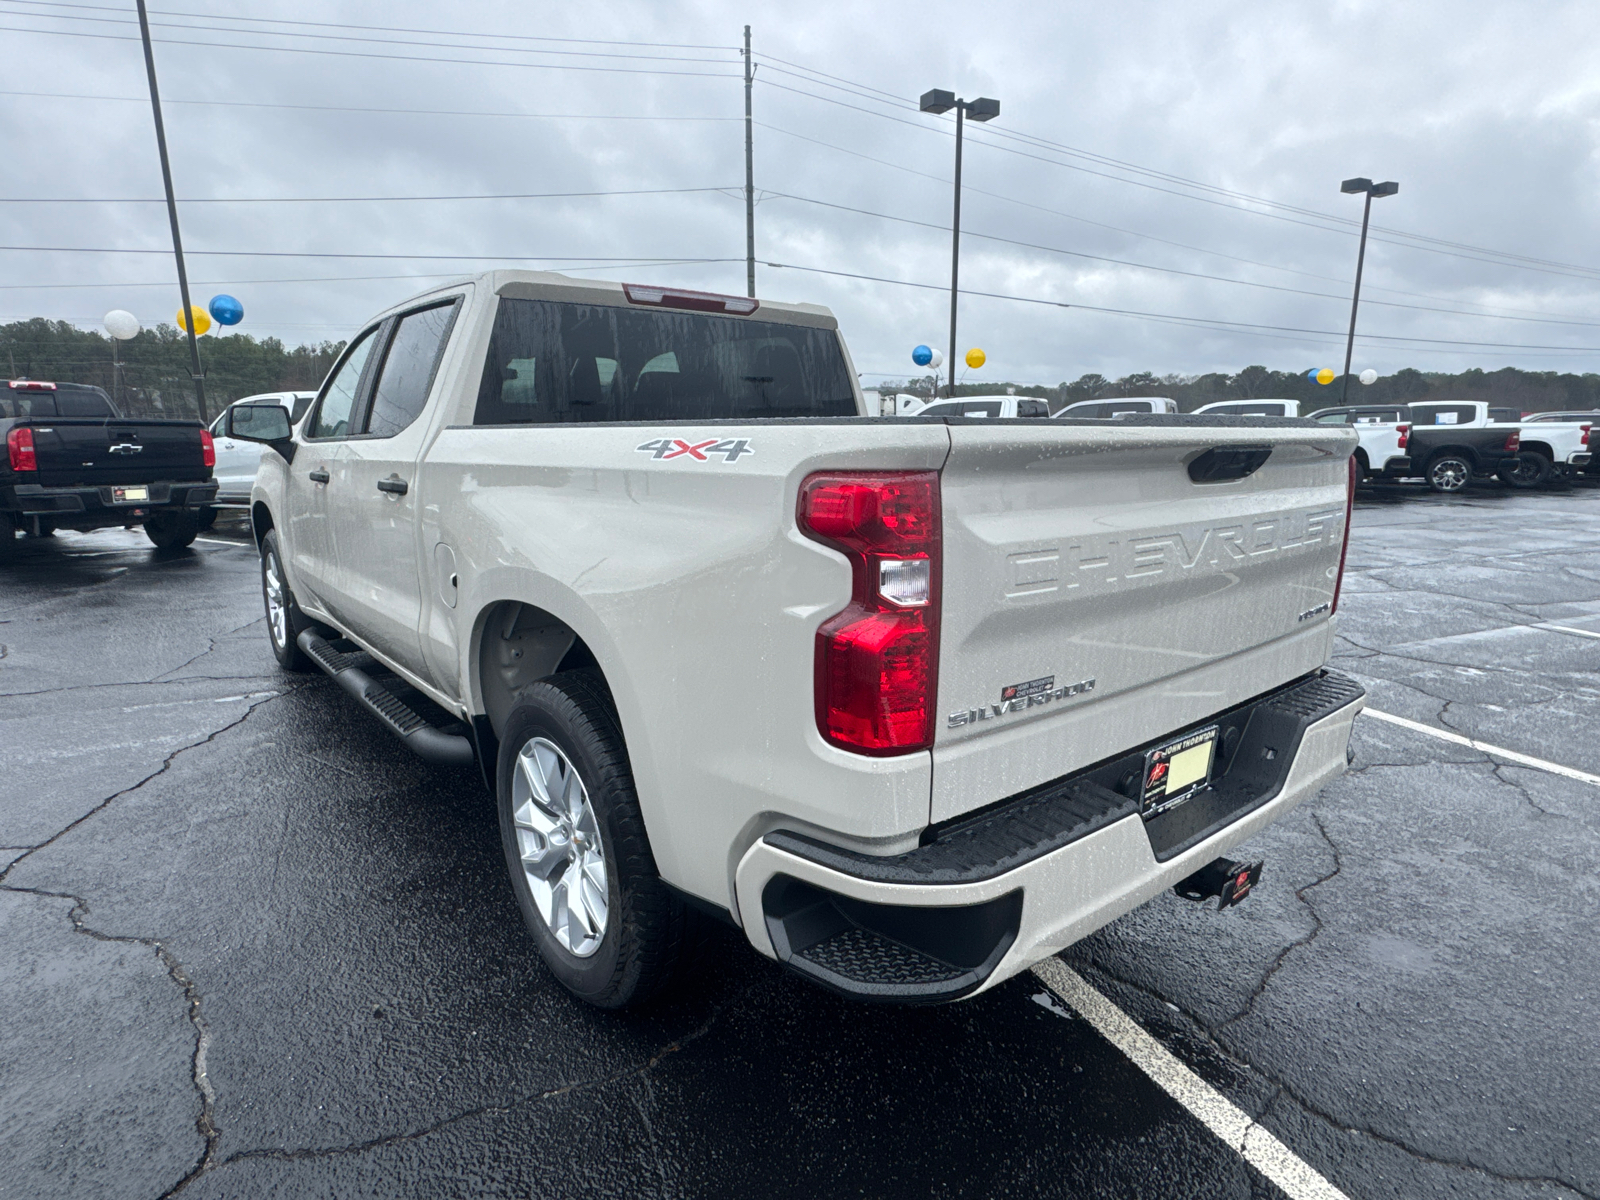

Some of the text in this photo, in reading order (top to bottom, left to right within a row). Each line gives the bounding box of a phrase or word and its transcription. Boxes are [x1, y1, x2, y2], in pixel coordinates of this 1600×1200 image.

[1004, 506, 1344, 598] CHEVROLET
[1016, 685, 1045, 697] CHEVROLET
[1030, 677, 1054, 689] THORNTON
[947, 678, 1097, 729] SILVERADO
[1165, 729, 1216, 756] JOHN THORNTON
